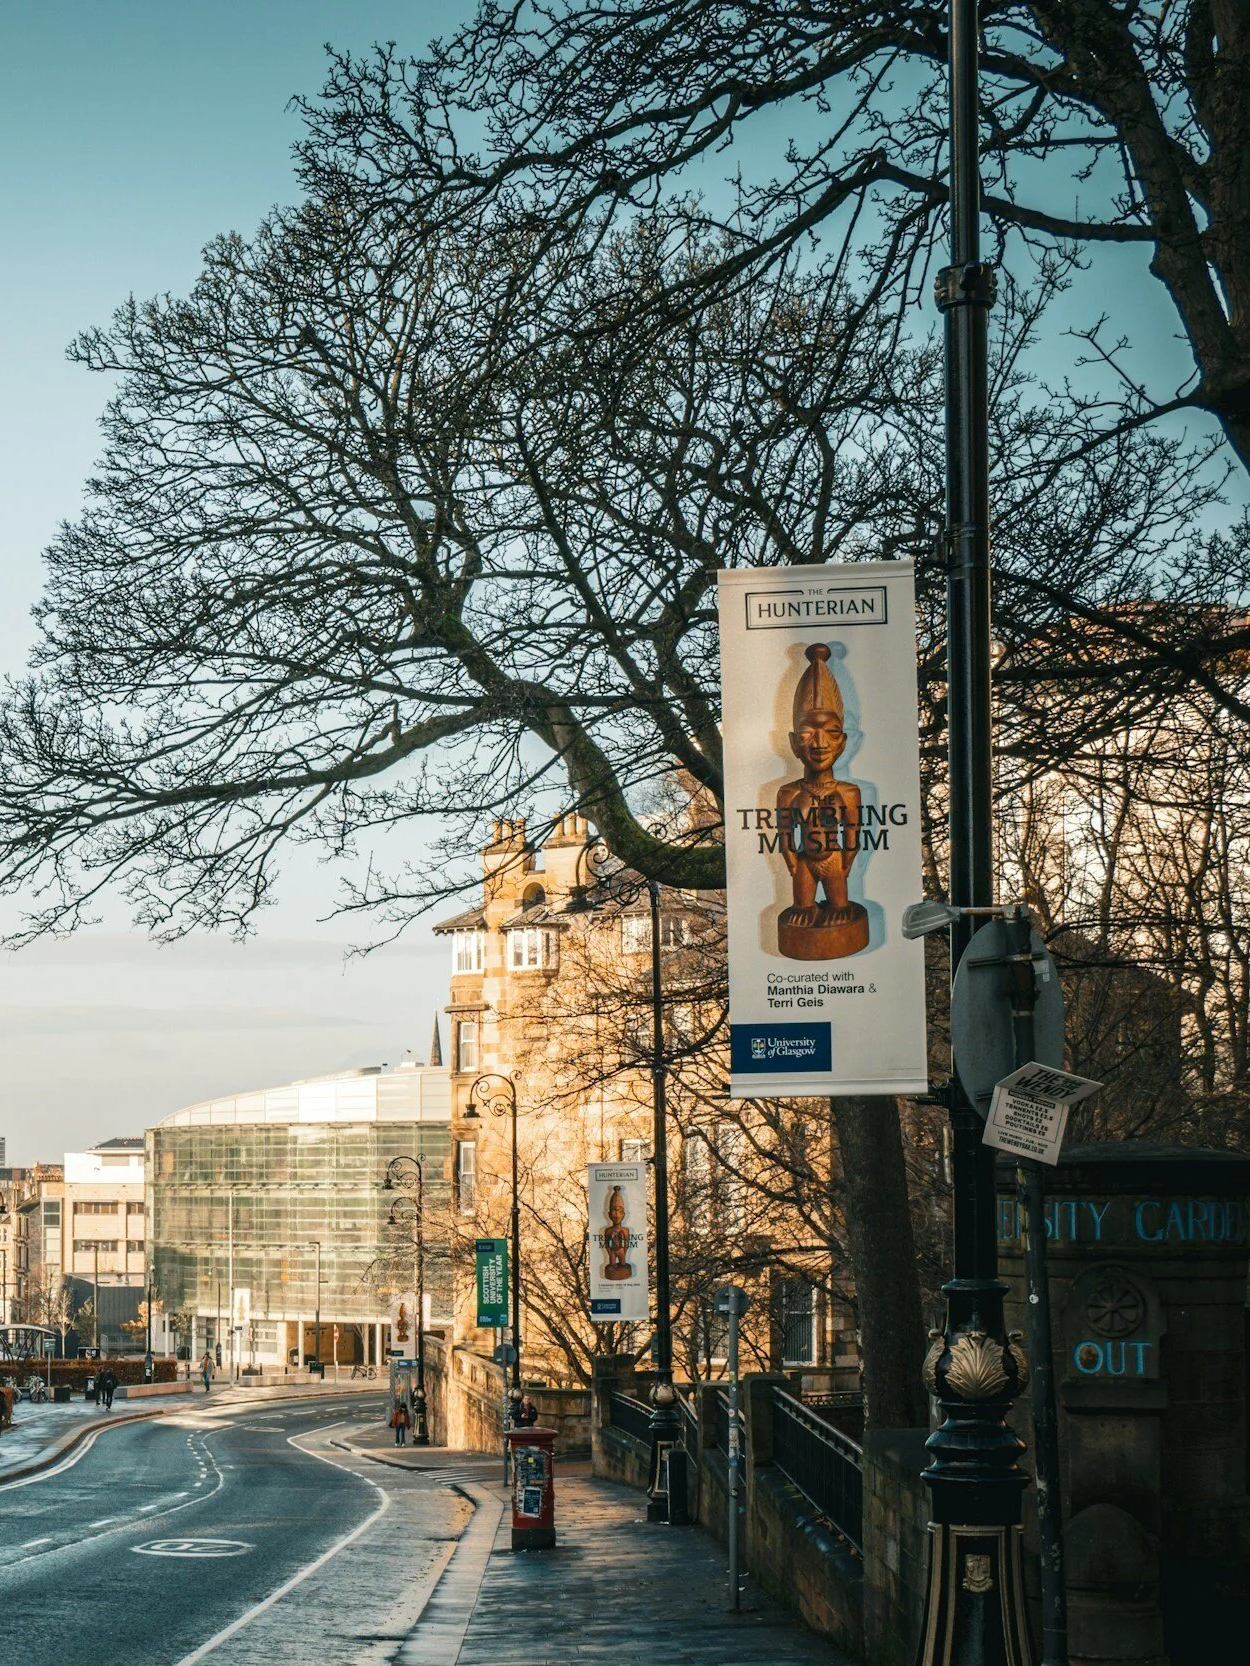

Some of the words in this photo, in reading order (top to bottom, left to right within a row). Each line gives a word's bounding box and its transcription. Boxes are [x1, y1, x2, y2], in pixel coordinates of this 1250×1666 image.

[758, 598, 875, 618] HUNTERIAN
[809, 795, 835, 806] THE
[736, 804, 908, 830] TREMBLING
[758, 829, 889, 854] MUSEUM
[767, 971, 829, 984] Co-curated
[832, 971, 855, 981] with
[767, 985, 814, 996] Manthia
[817, 983, 865, 995] Diawara
[868, 982, 877, 994] &
[767, 998, 793, 1008] Terri
[797, 996, 824, 1008] Geis
[768, 1037, 816, 1048] University
[768, 1046, 778, 1058] of
[777, 1046, 816, 1059] Glasgow
[1031, 1069, 1059, 1086] THE
[1015, 1077, 1075, 1099] WENDY
[1012, 1099, 1034, 1111] VODKA
[1005, 1115, 1040, 1129] COCKTAILS
[598, 1171, 635, 1179] HUNTERIAN
[496, 1293, 503, 1305] OF
[1073, 1339, 1153, 1376] OUT
